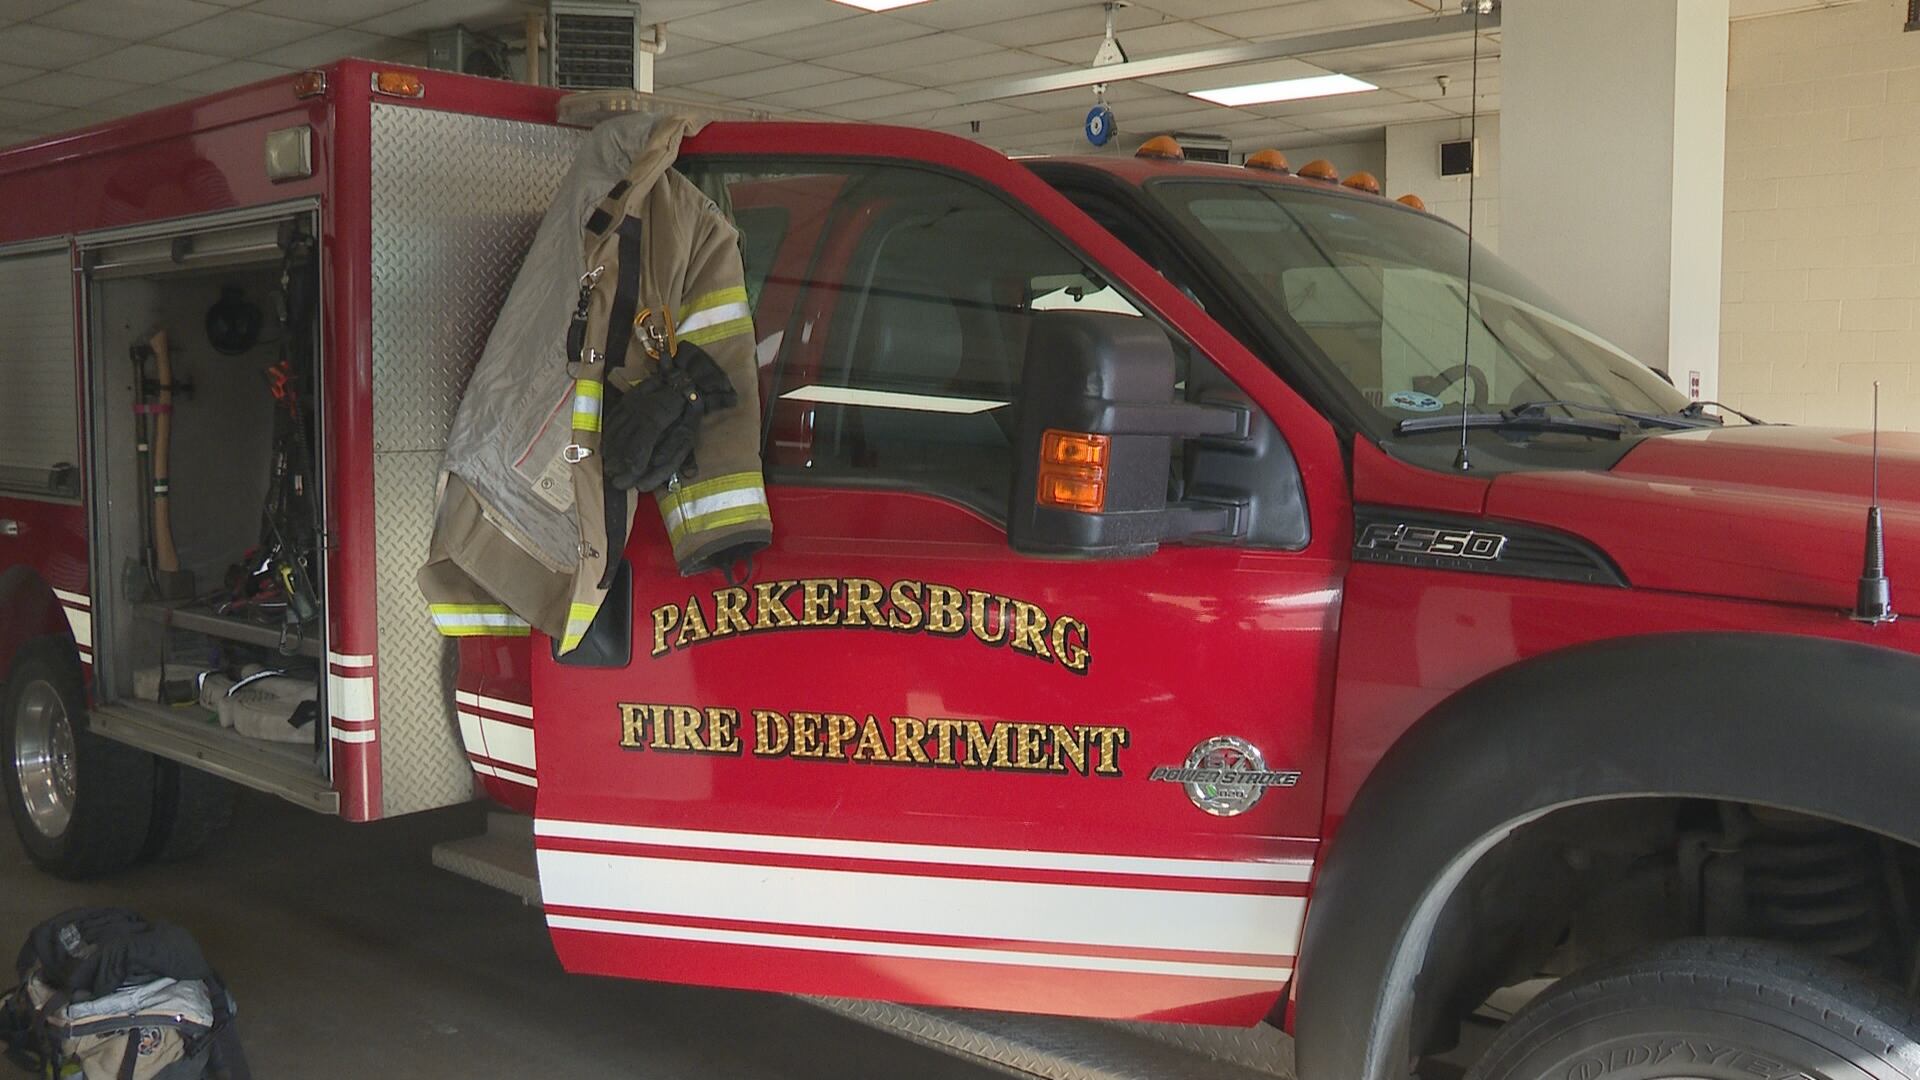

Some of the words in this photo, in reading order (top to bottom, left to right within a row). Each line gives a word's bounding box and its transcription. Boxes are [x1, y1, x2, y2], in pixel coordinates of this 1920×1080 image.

[651, 577, 1091, 674] PARKERSBURG
[618, 702, 742, 757] FIRE
[751, 709, 1129, 776] DEPARTMENT
[1150, 767, 1221, 783] POWER
[1221, 771, 1301, 787] STROKE
